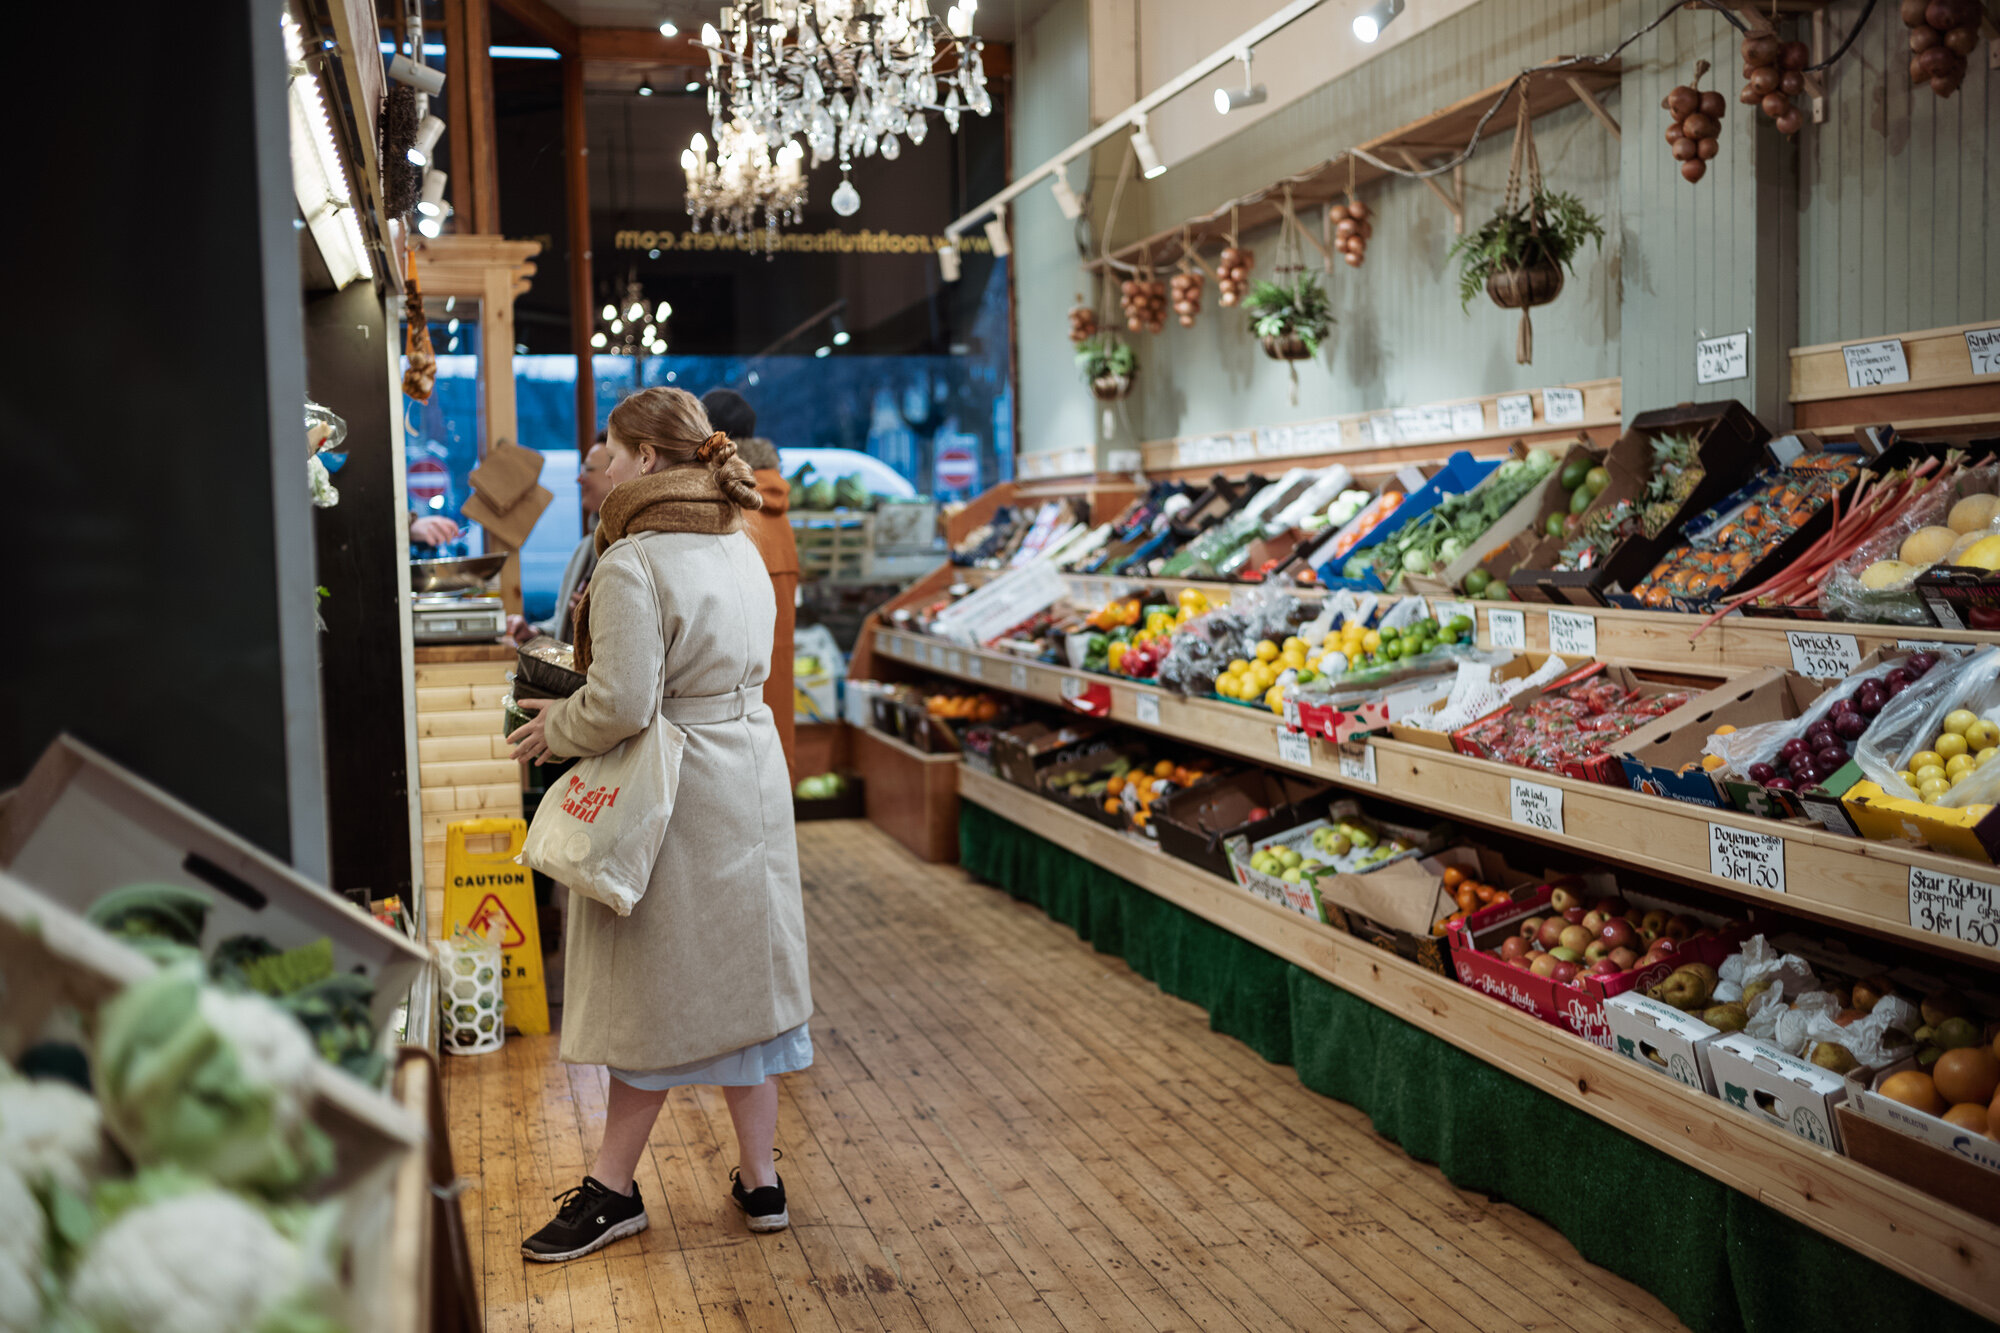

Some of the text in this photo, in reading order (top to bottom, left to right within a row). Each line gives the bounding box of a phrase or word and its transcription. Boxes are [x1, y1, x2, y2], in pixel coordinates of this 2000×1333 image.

[579, 786, 620, 809] girl
[561, 798, 602, 824] and
[1714, 826, 1760, 848] Doyenne
[1732, 845, 1769, 863] Comice
[453, 873, 525, 888] CAUTION
[1911, 870, 1993, 913] Star Ruby
[1912, 889, 1967, 912] grapefruit
[1920, 907, 1935, 932] 3
[1475, 973, 1542, 1018] Pink Lady
[1560, 997, 1609, 1031] Pink
